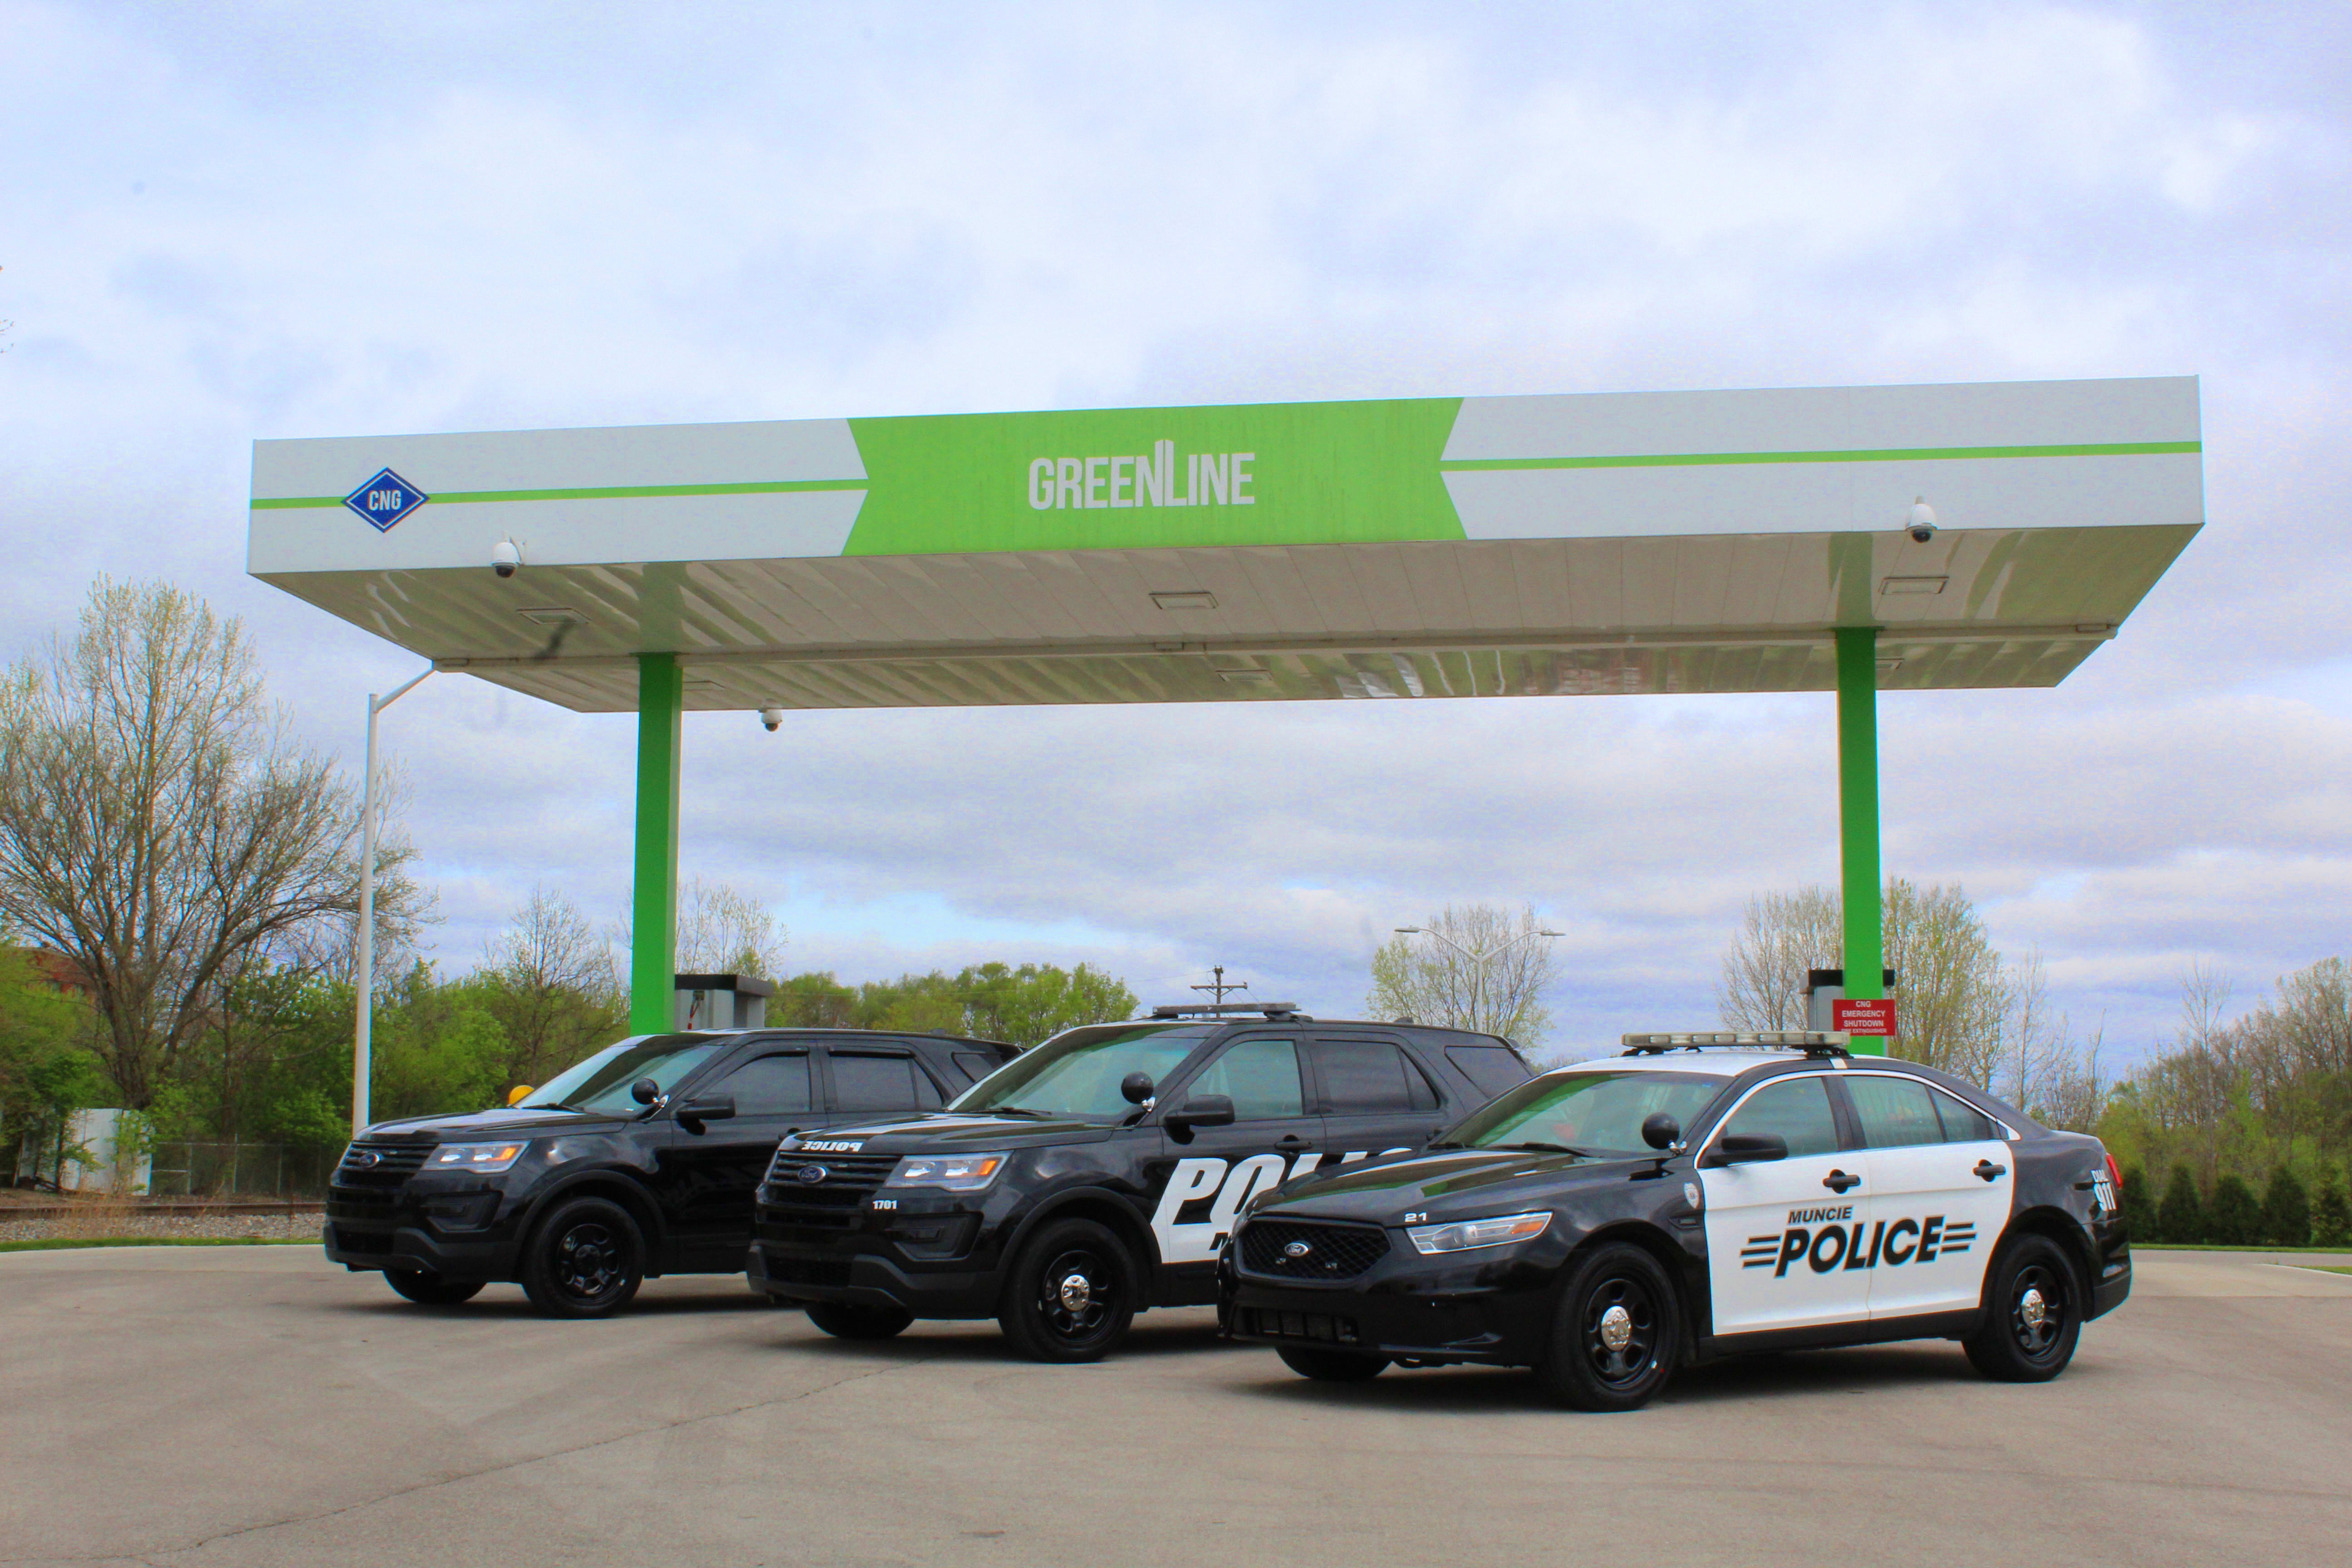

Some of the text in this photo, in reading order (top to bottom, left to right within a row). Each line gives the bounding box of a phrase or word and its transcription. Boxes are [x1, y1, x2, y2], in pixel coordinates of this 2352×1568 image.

[1029, 439, 1255, 510] GREENLINE
[367, 490, 402, 511] CNG
[2090, 1169, 2109, 1183] DIAL
[872, 1200, 897, 1210] 1701
[2093, 1182, 2117, 1211] 911
[1404, 1212, 1427, 1222] 21
[1788, 1205, 1853, 1224] MUNCIE
[1774, 1214, 1946, 1279] POLICE
